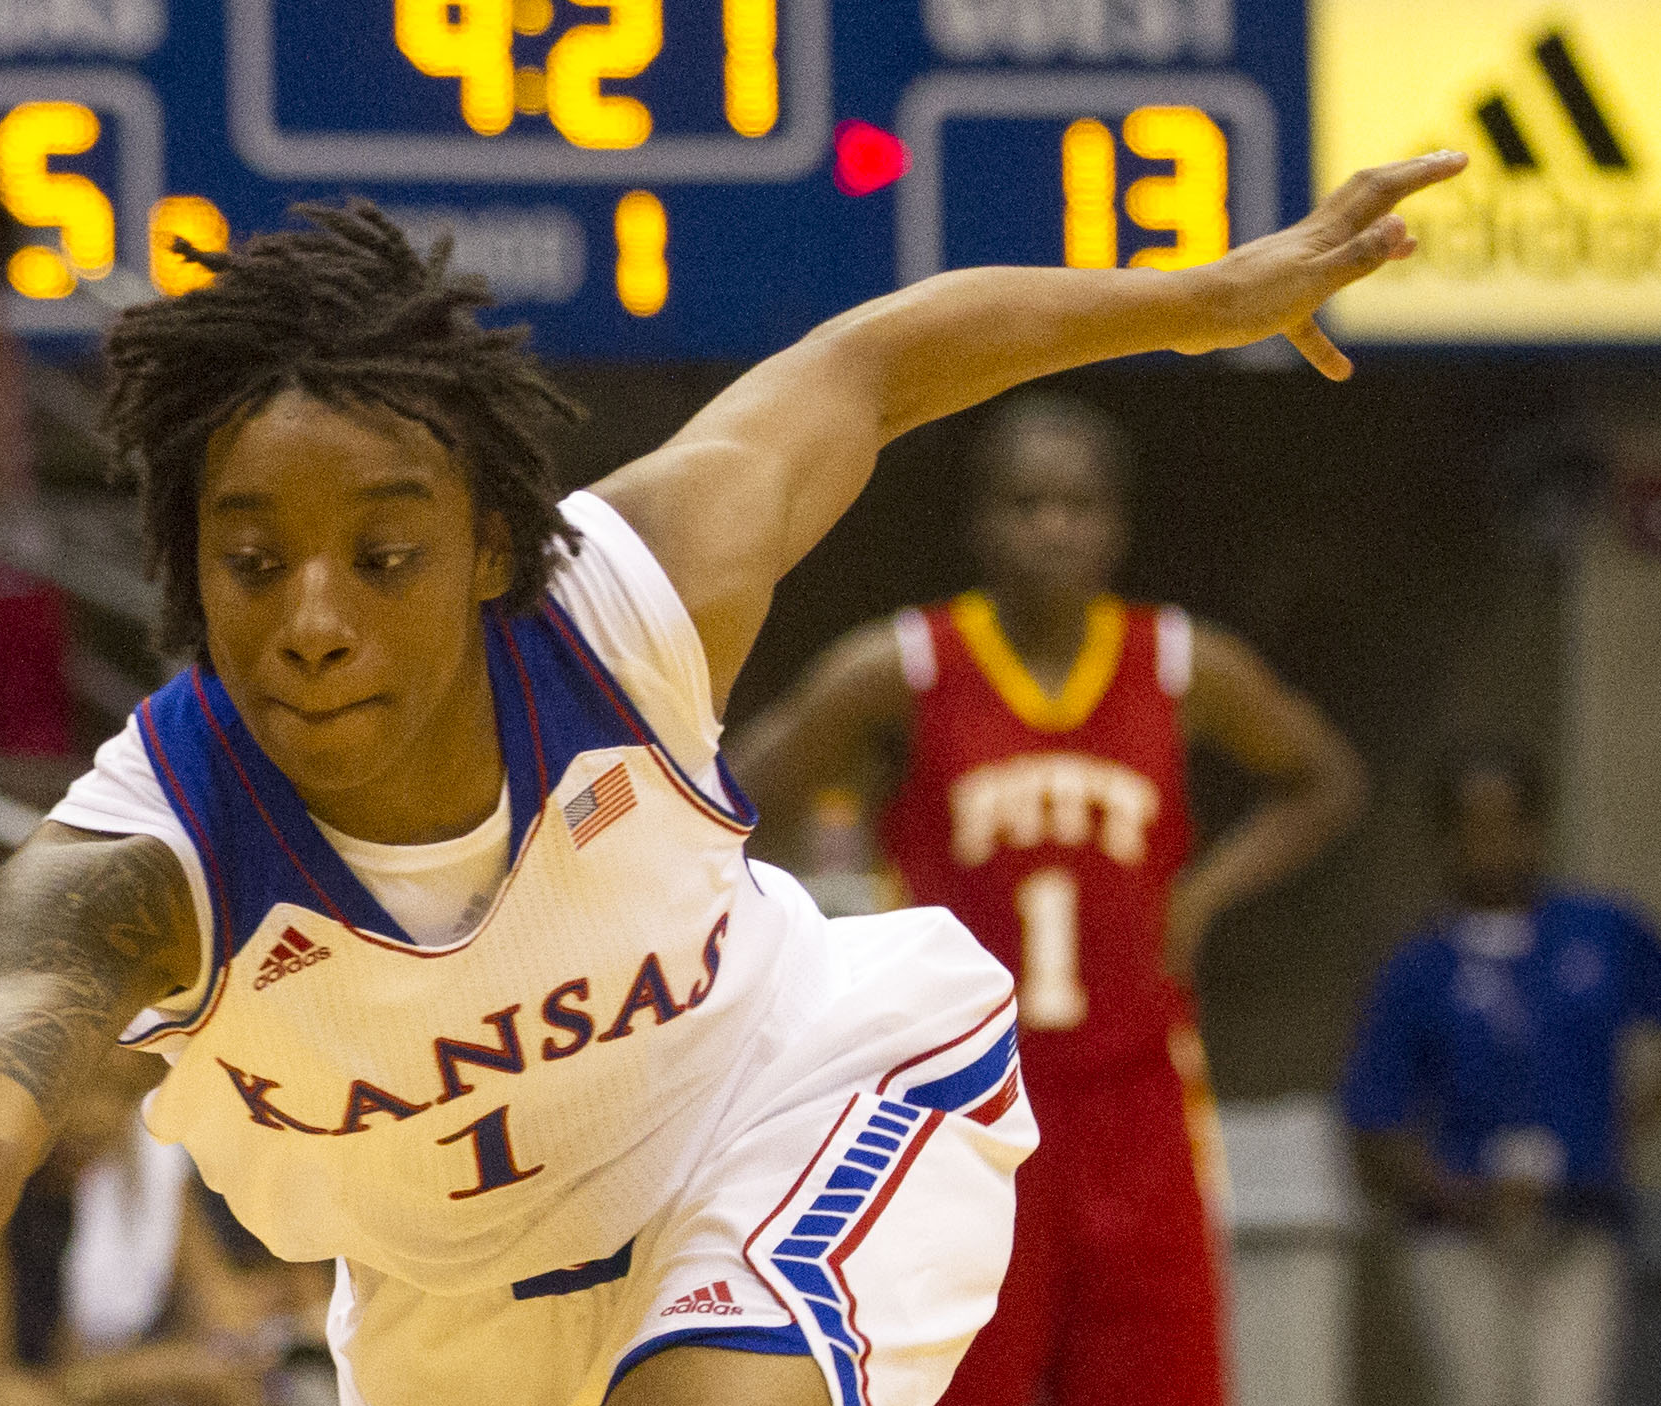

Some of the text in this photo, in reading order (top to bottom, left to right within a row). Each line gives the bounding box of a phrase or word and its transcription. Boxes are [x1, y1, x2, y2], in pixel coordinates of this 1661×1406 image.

[1061, 105, 1230, 270] 13
[614, 190, 669, 318] 1
[949, 750, 1161, 868] PITT
[254, 946, 332, 991] adidas
[1015, 866, 1089, 1031] 1
[215, 911, 730, 1137] KANSAS
[435, 1104, 546, 1201] 1
[660, 1298, 744, 1317] adidas
